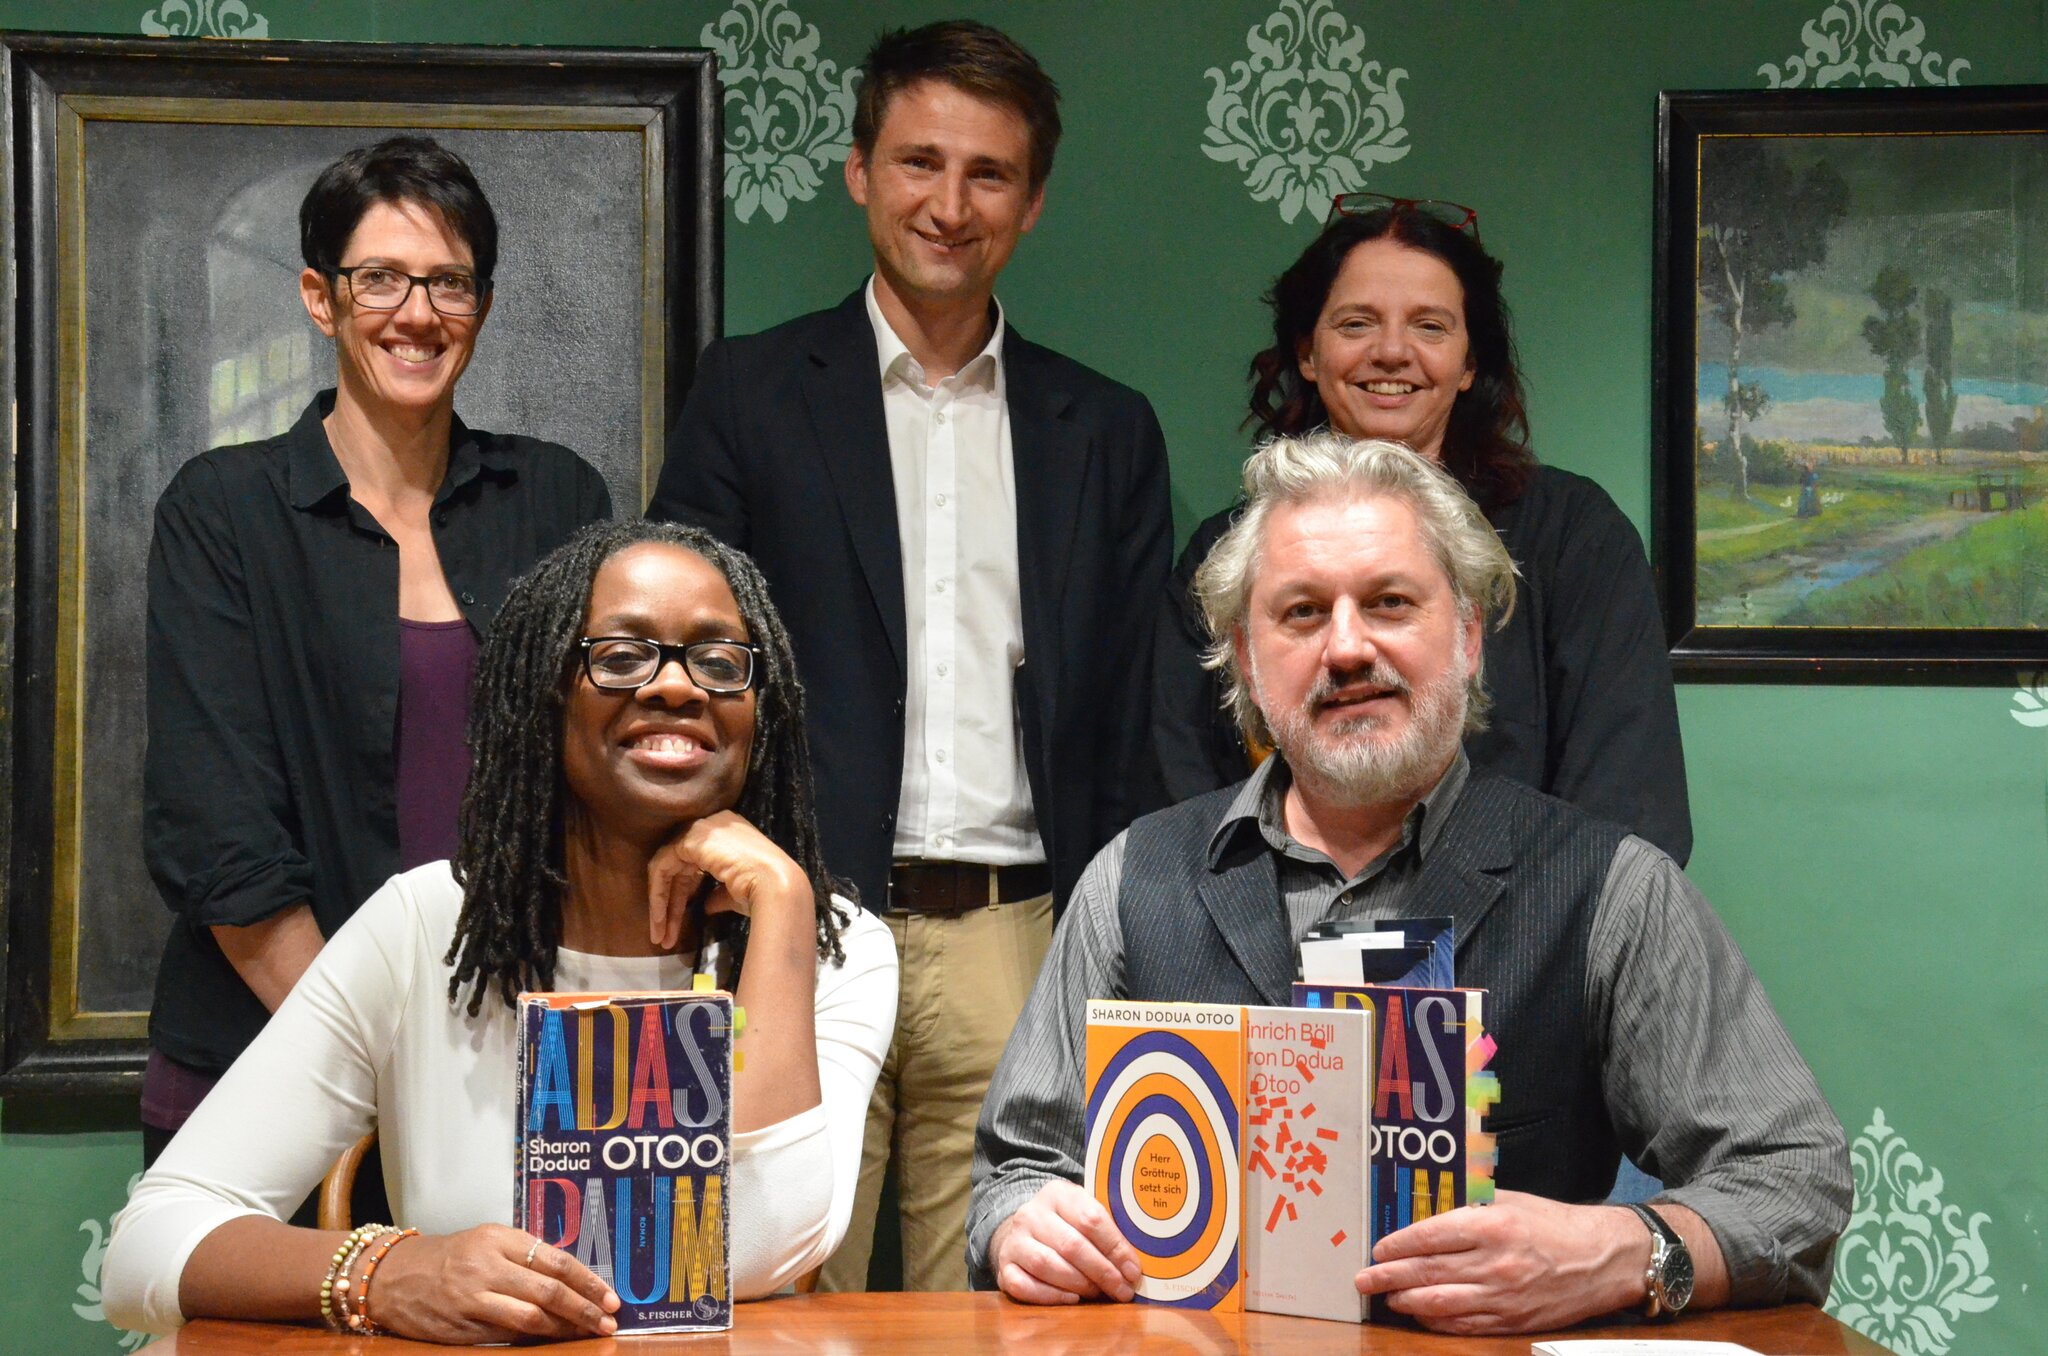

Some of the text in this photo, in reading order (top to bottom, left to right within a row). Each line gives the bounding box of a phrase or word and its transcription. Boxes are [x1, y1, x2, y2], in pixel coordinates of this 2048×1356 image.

[1092, 1008, 1234, 1025] SHARON DODUA OTOO
[1301, 1023, 1334, 1043] Böll
[1282, 1048, 1344, 1070] Dodua
[1306, 992, 1457, 1122] AS
[528, 1002, 725, 1130] ADAS
[1254, 1073, 1300, 1094] Otoo
[529, 1139, 591, 1155] Sharon
[602, 1134, 724, 1170] OTOO
[530, 1156, 591, 1172] Dodua
[1150, 1153, 1171, 1163] Herr
[1140, 1167, 1181, 1181] Gröttrup
[1139, 1184, 1182, 1194] setzt sich
[1153, 1198, 1168, 1208] hin
[639, 1216, 647, 1248] ROMAN
[649, 1310, 693, 1320] FISCHER
